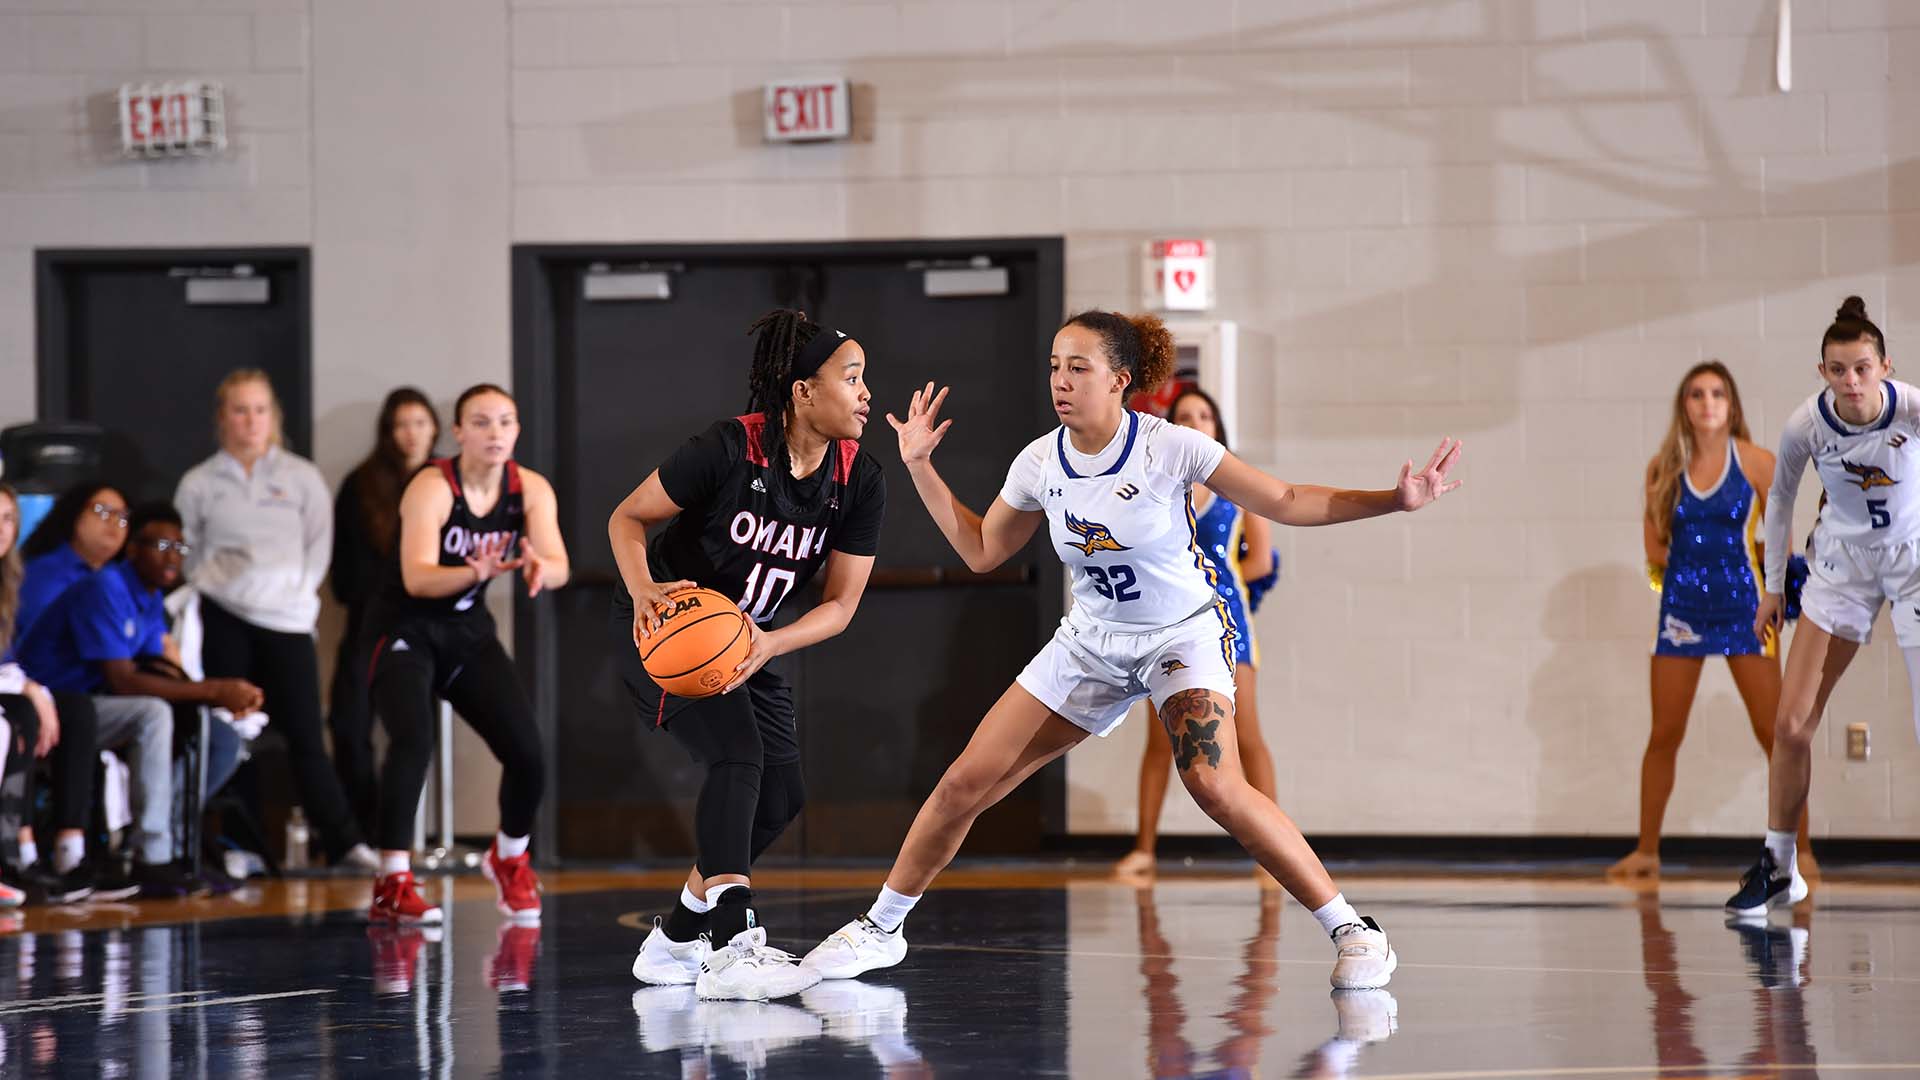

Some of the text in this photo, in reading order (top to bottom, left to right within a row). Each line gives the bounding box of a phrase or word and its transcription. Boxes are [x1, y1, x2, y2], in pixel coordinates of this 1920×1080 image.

[128, 95, 188, 140] EXIT
[774, 84, 835, 132] EXIT
[1866, 498, 1891, 529] 5
[736, 563, 796, 624] 10
[1083, 564, 1141, 602] 32
